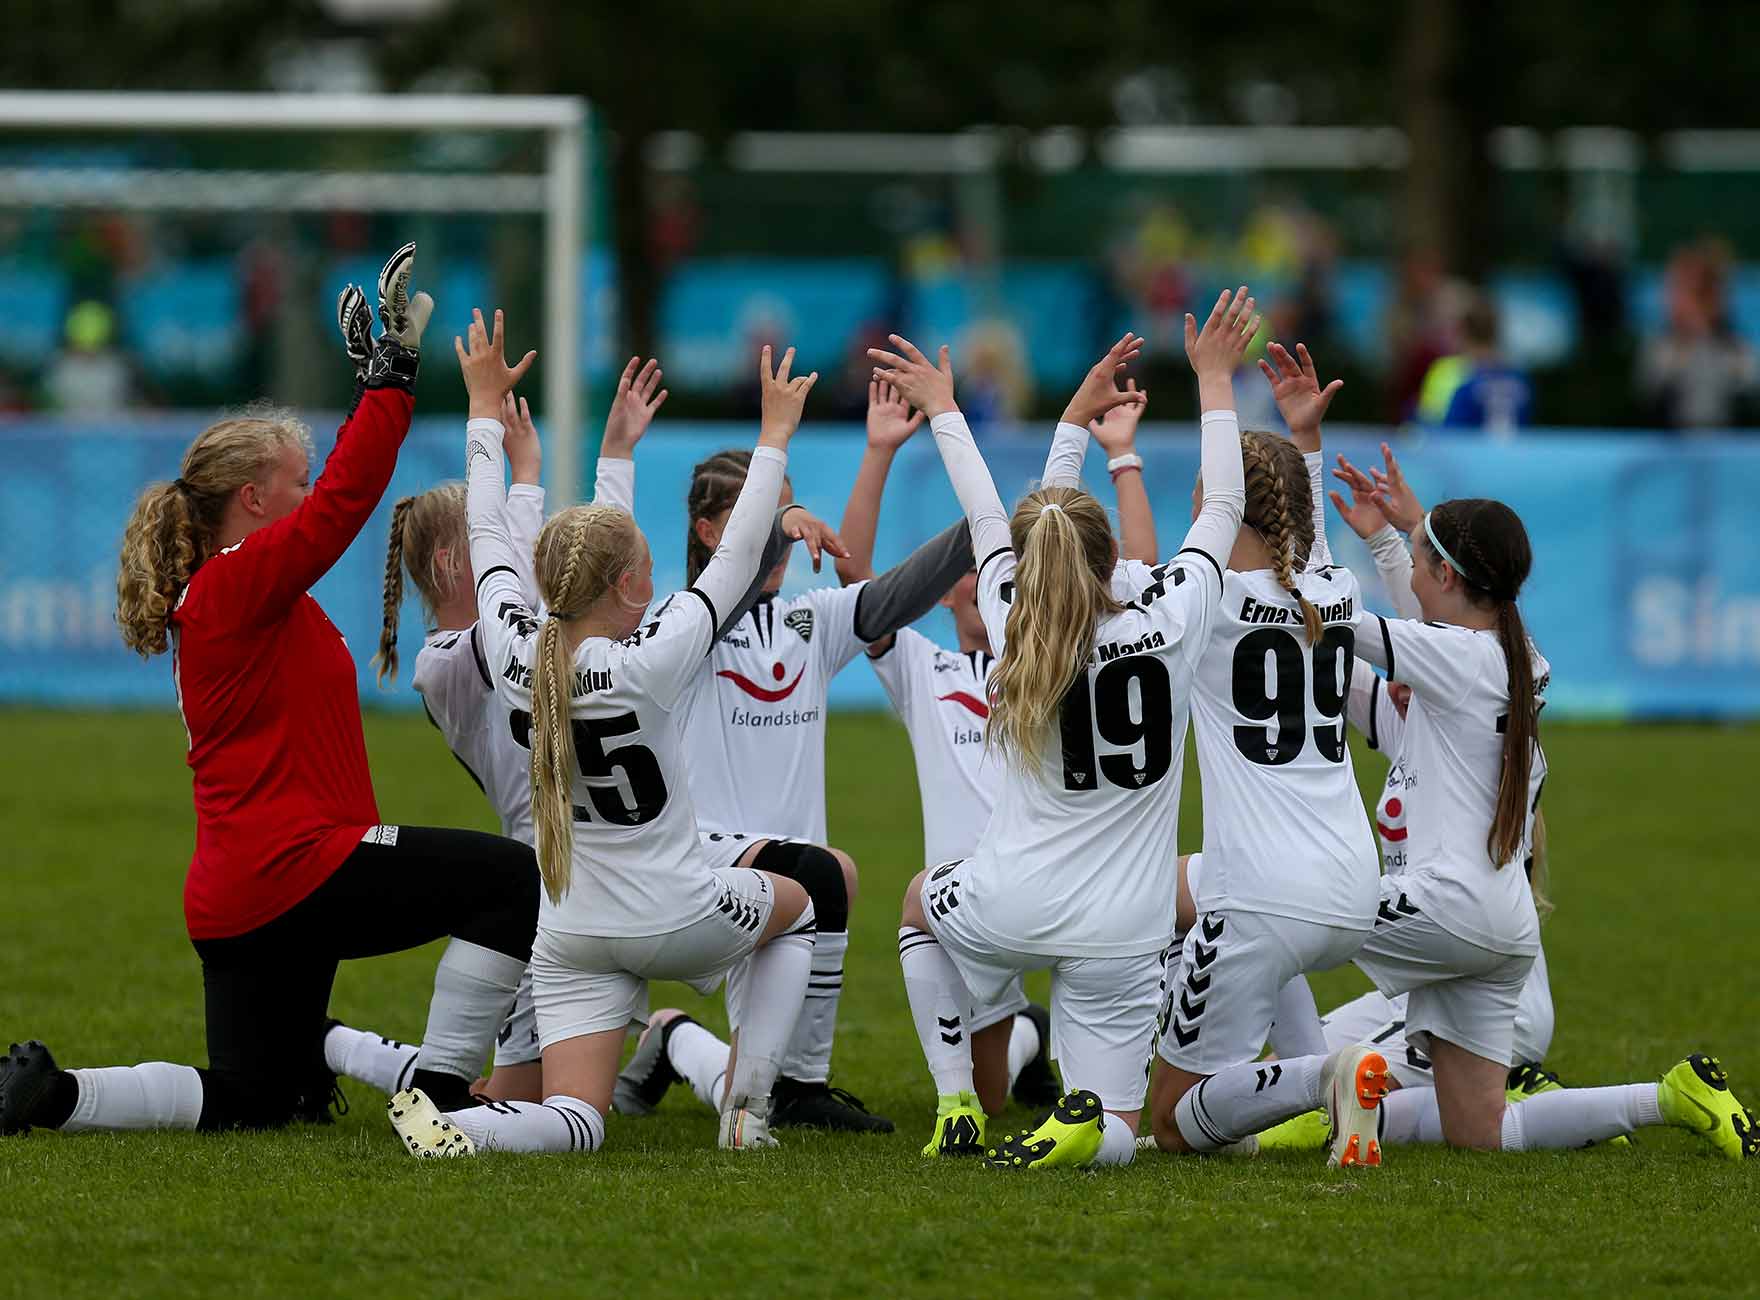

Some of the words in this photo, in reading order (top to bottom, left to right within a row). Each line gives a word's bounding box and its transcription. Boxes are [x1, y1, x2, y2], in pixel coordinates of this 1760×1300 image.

[1098, 630, 1166, 662] María
[1239, 596, 1289, 624] Erna
[1059, 655, 1173, 790] 19
[1232, 624, 1355, 766] 99
